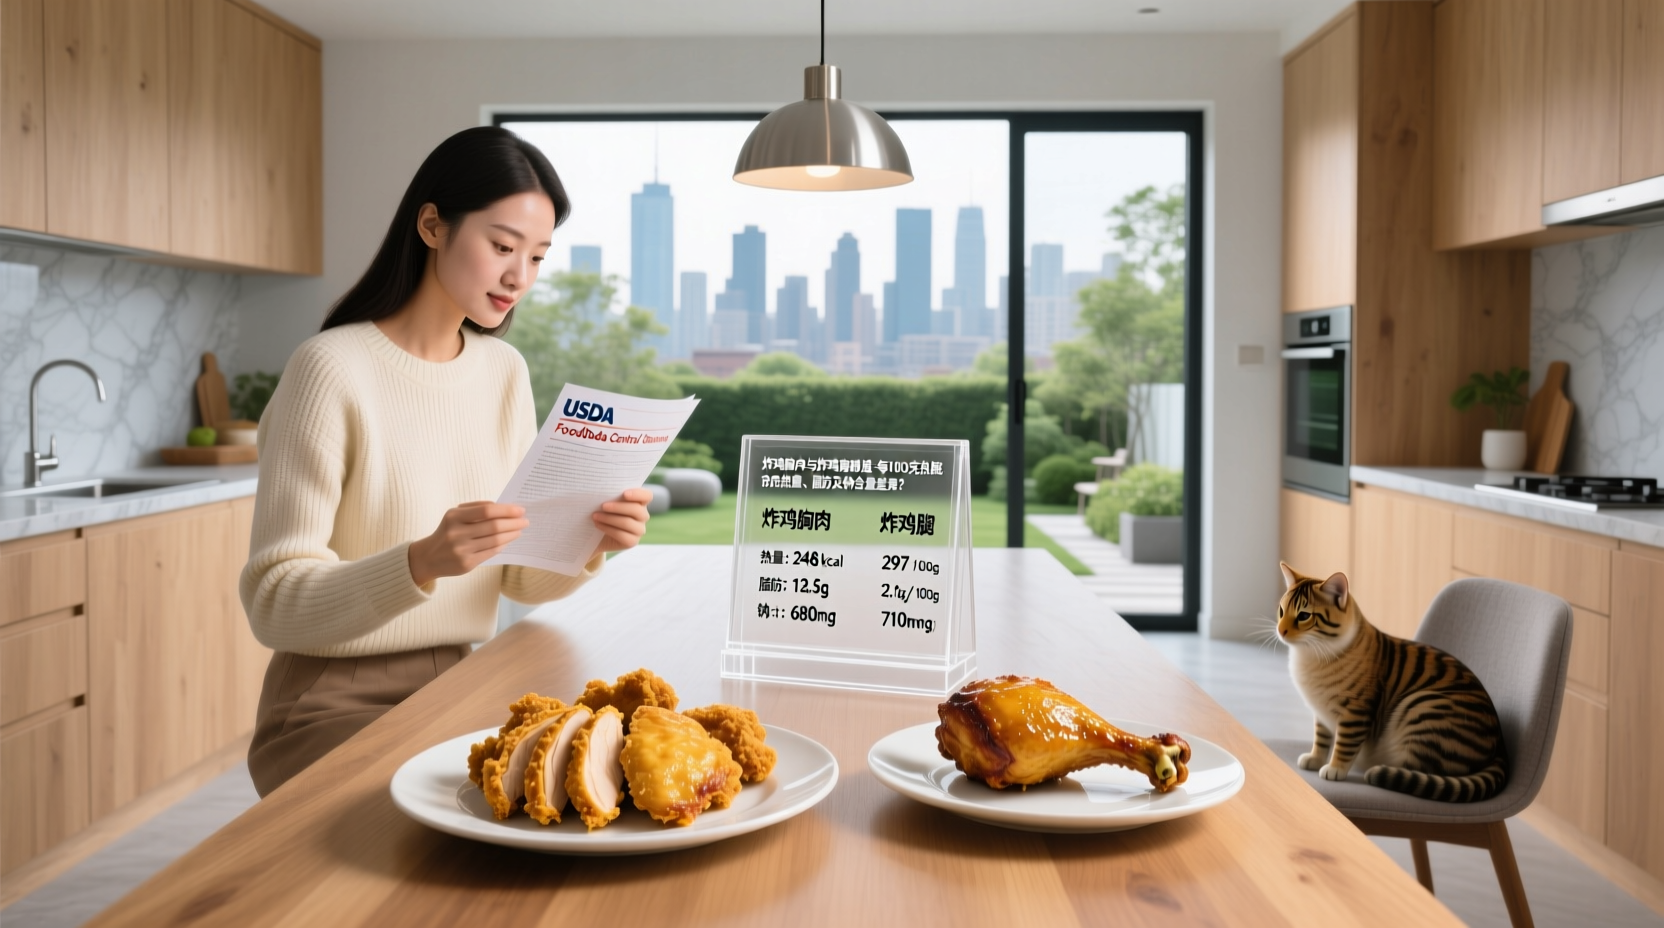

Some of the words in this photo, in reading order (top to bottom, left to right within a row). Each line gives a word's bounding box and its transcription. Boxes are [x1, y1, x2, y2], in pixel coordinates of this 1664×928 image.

[563, 398, 614, 425] USDA
[761, 507, 831, 531] 炸鸡胸肉
[881, 554, 910, 572] 297
[792, 577, 829, 599] 12.5g
[790, 605, 837, 628] 680mg
